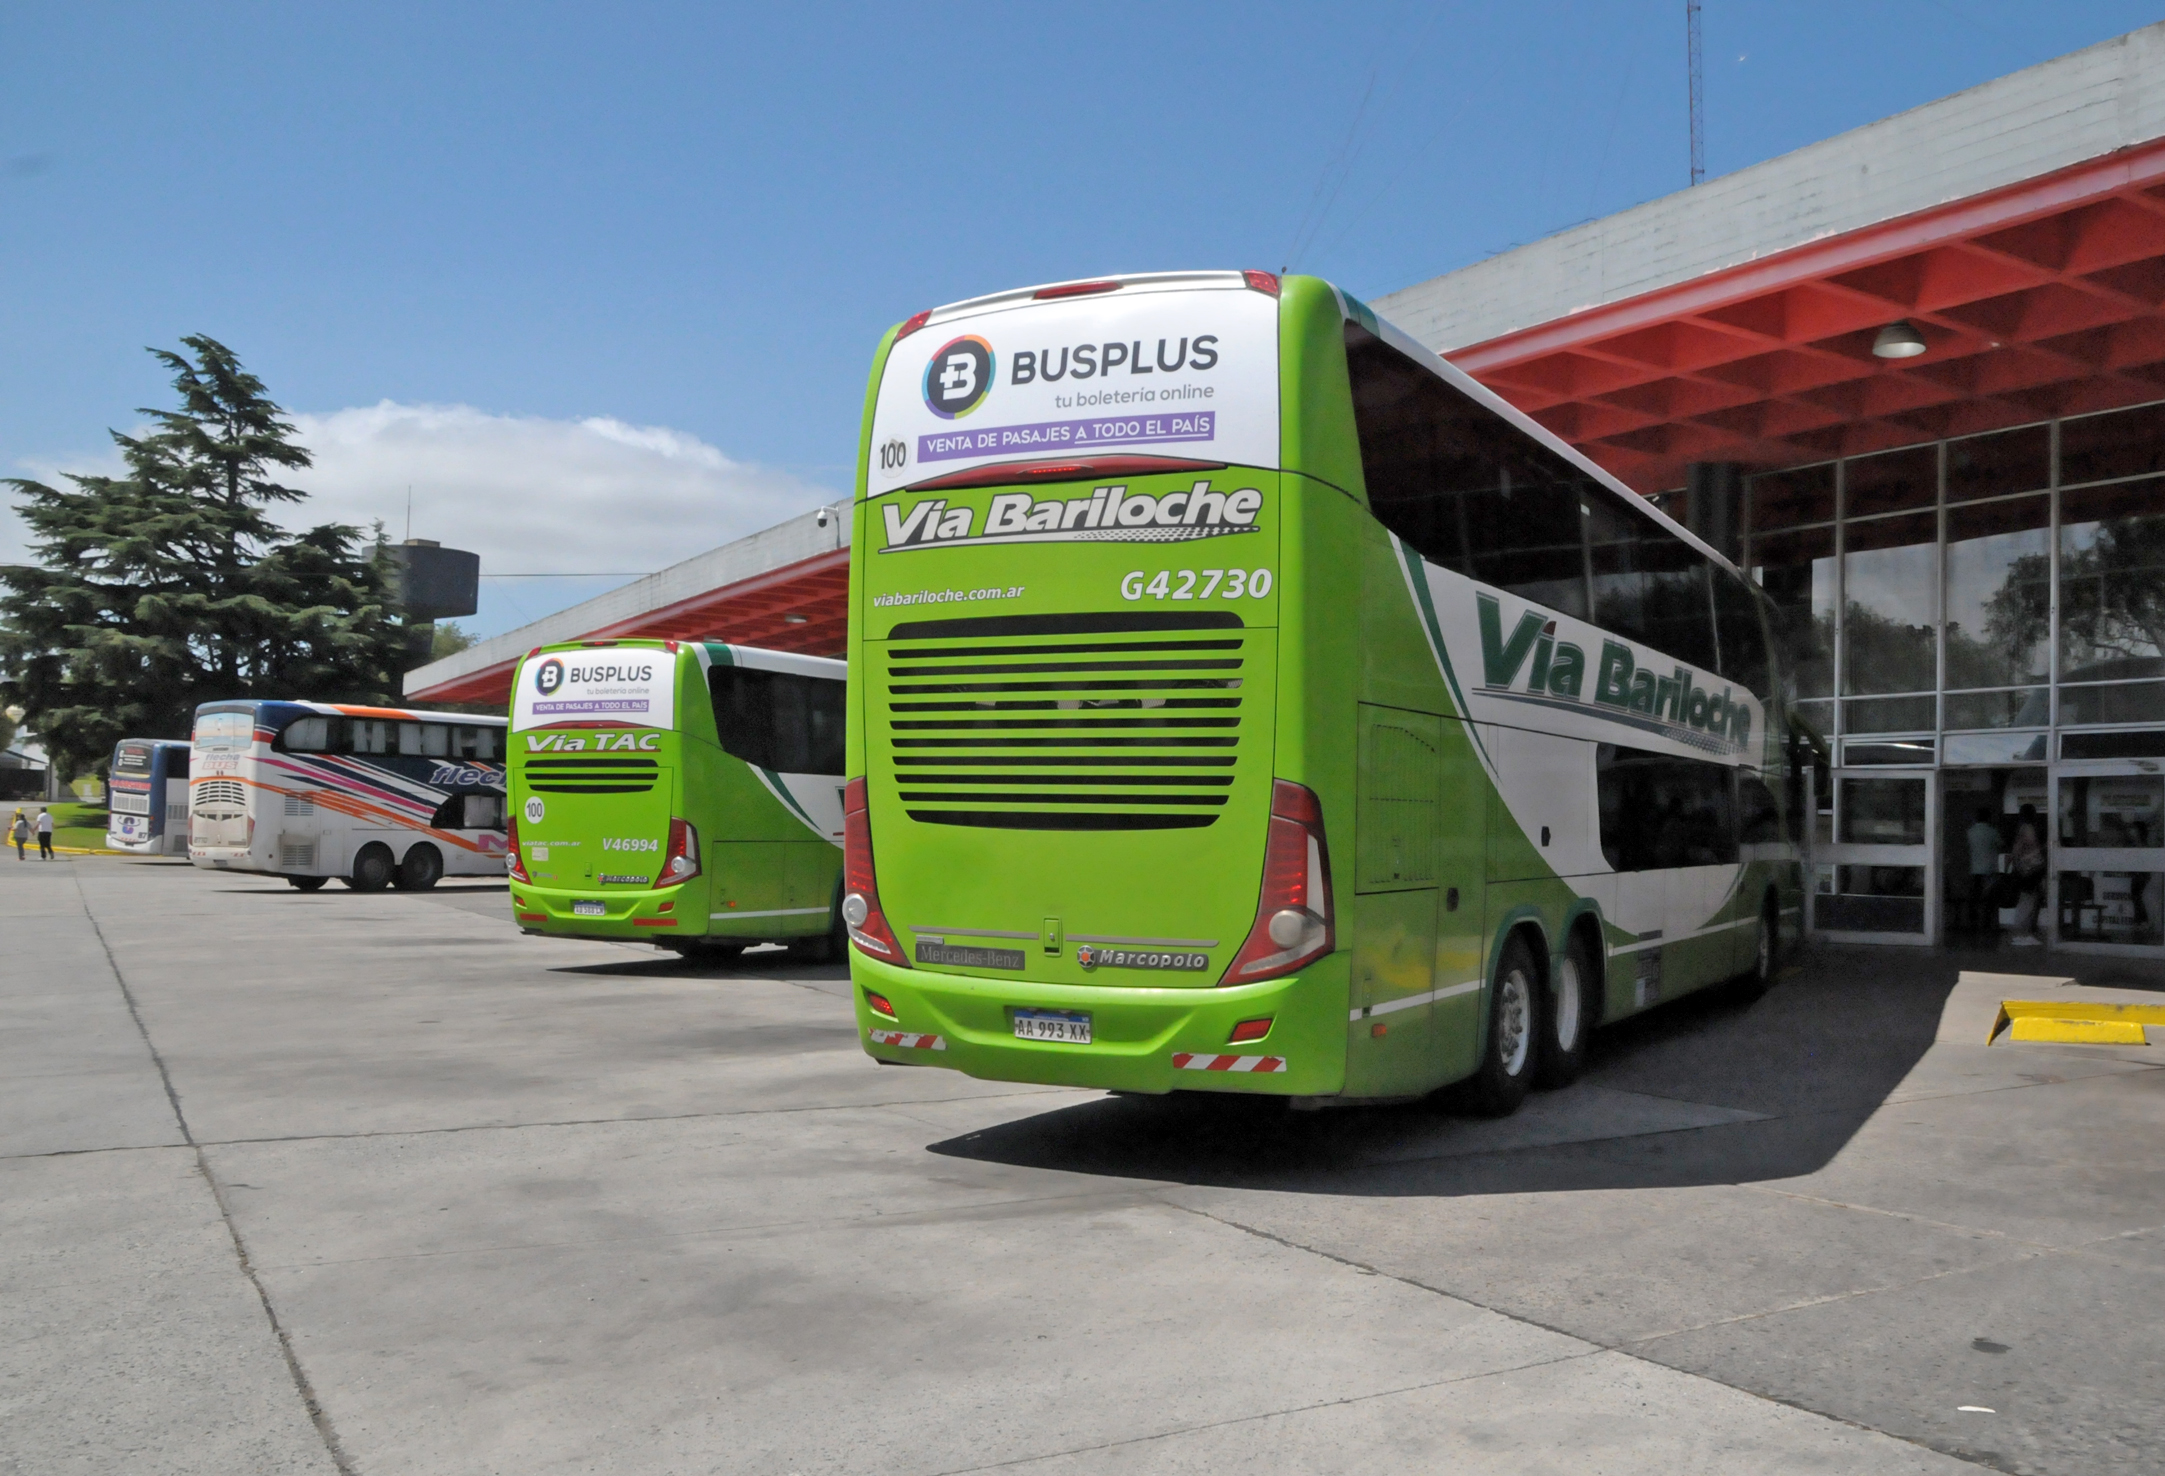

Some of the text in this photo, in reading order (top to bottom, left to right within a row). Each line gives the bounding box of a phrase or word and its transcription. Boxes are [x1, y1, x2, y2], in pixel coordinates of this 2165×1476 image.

[1010, 334, 1220, 386] BUSPLUS
[1054, 385, 1215, 408] tu boletería online
[926, 415, 1211, 453] VENTA DE PASAJES A TODO EL PAÍS
[879, 441, 907, 470] 100
[981, 480, 1263, 537] Bariloche
[1119, 567, 1273, 602] G42730
[872, 584, 1026, 608] viabariloche.com.ar
[570, 665, 652, 683] BUSPLUS
[1594, 637, 1751, 748] Bariloche
[536, 703, 554, 711] VENTA
[556, 703, 564, 711] DE
[565, 702, 593, 710] PASAJES
[594, 702, 600, 710] A
[622, 701, 630, 709] EL
[632, 700, 648, 709] PAÍS
[593, 733, 661, 752] TAC
[202, 761, 238, 770] BUS
[205, 753, 240, 761] flecha
[526, 802, 543, 818] 100
[602, 837, 658, 852] V46994
[605, 876, 648, 884] Marcopolo
[920, 945, 1020, 969] Mercedes-Benz
[1098, 948, 1206, 969] Marcopolo
[1018, 1019, 1087, 1041] AA 993 XX
